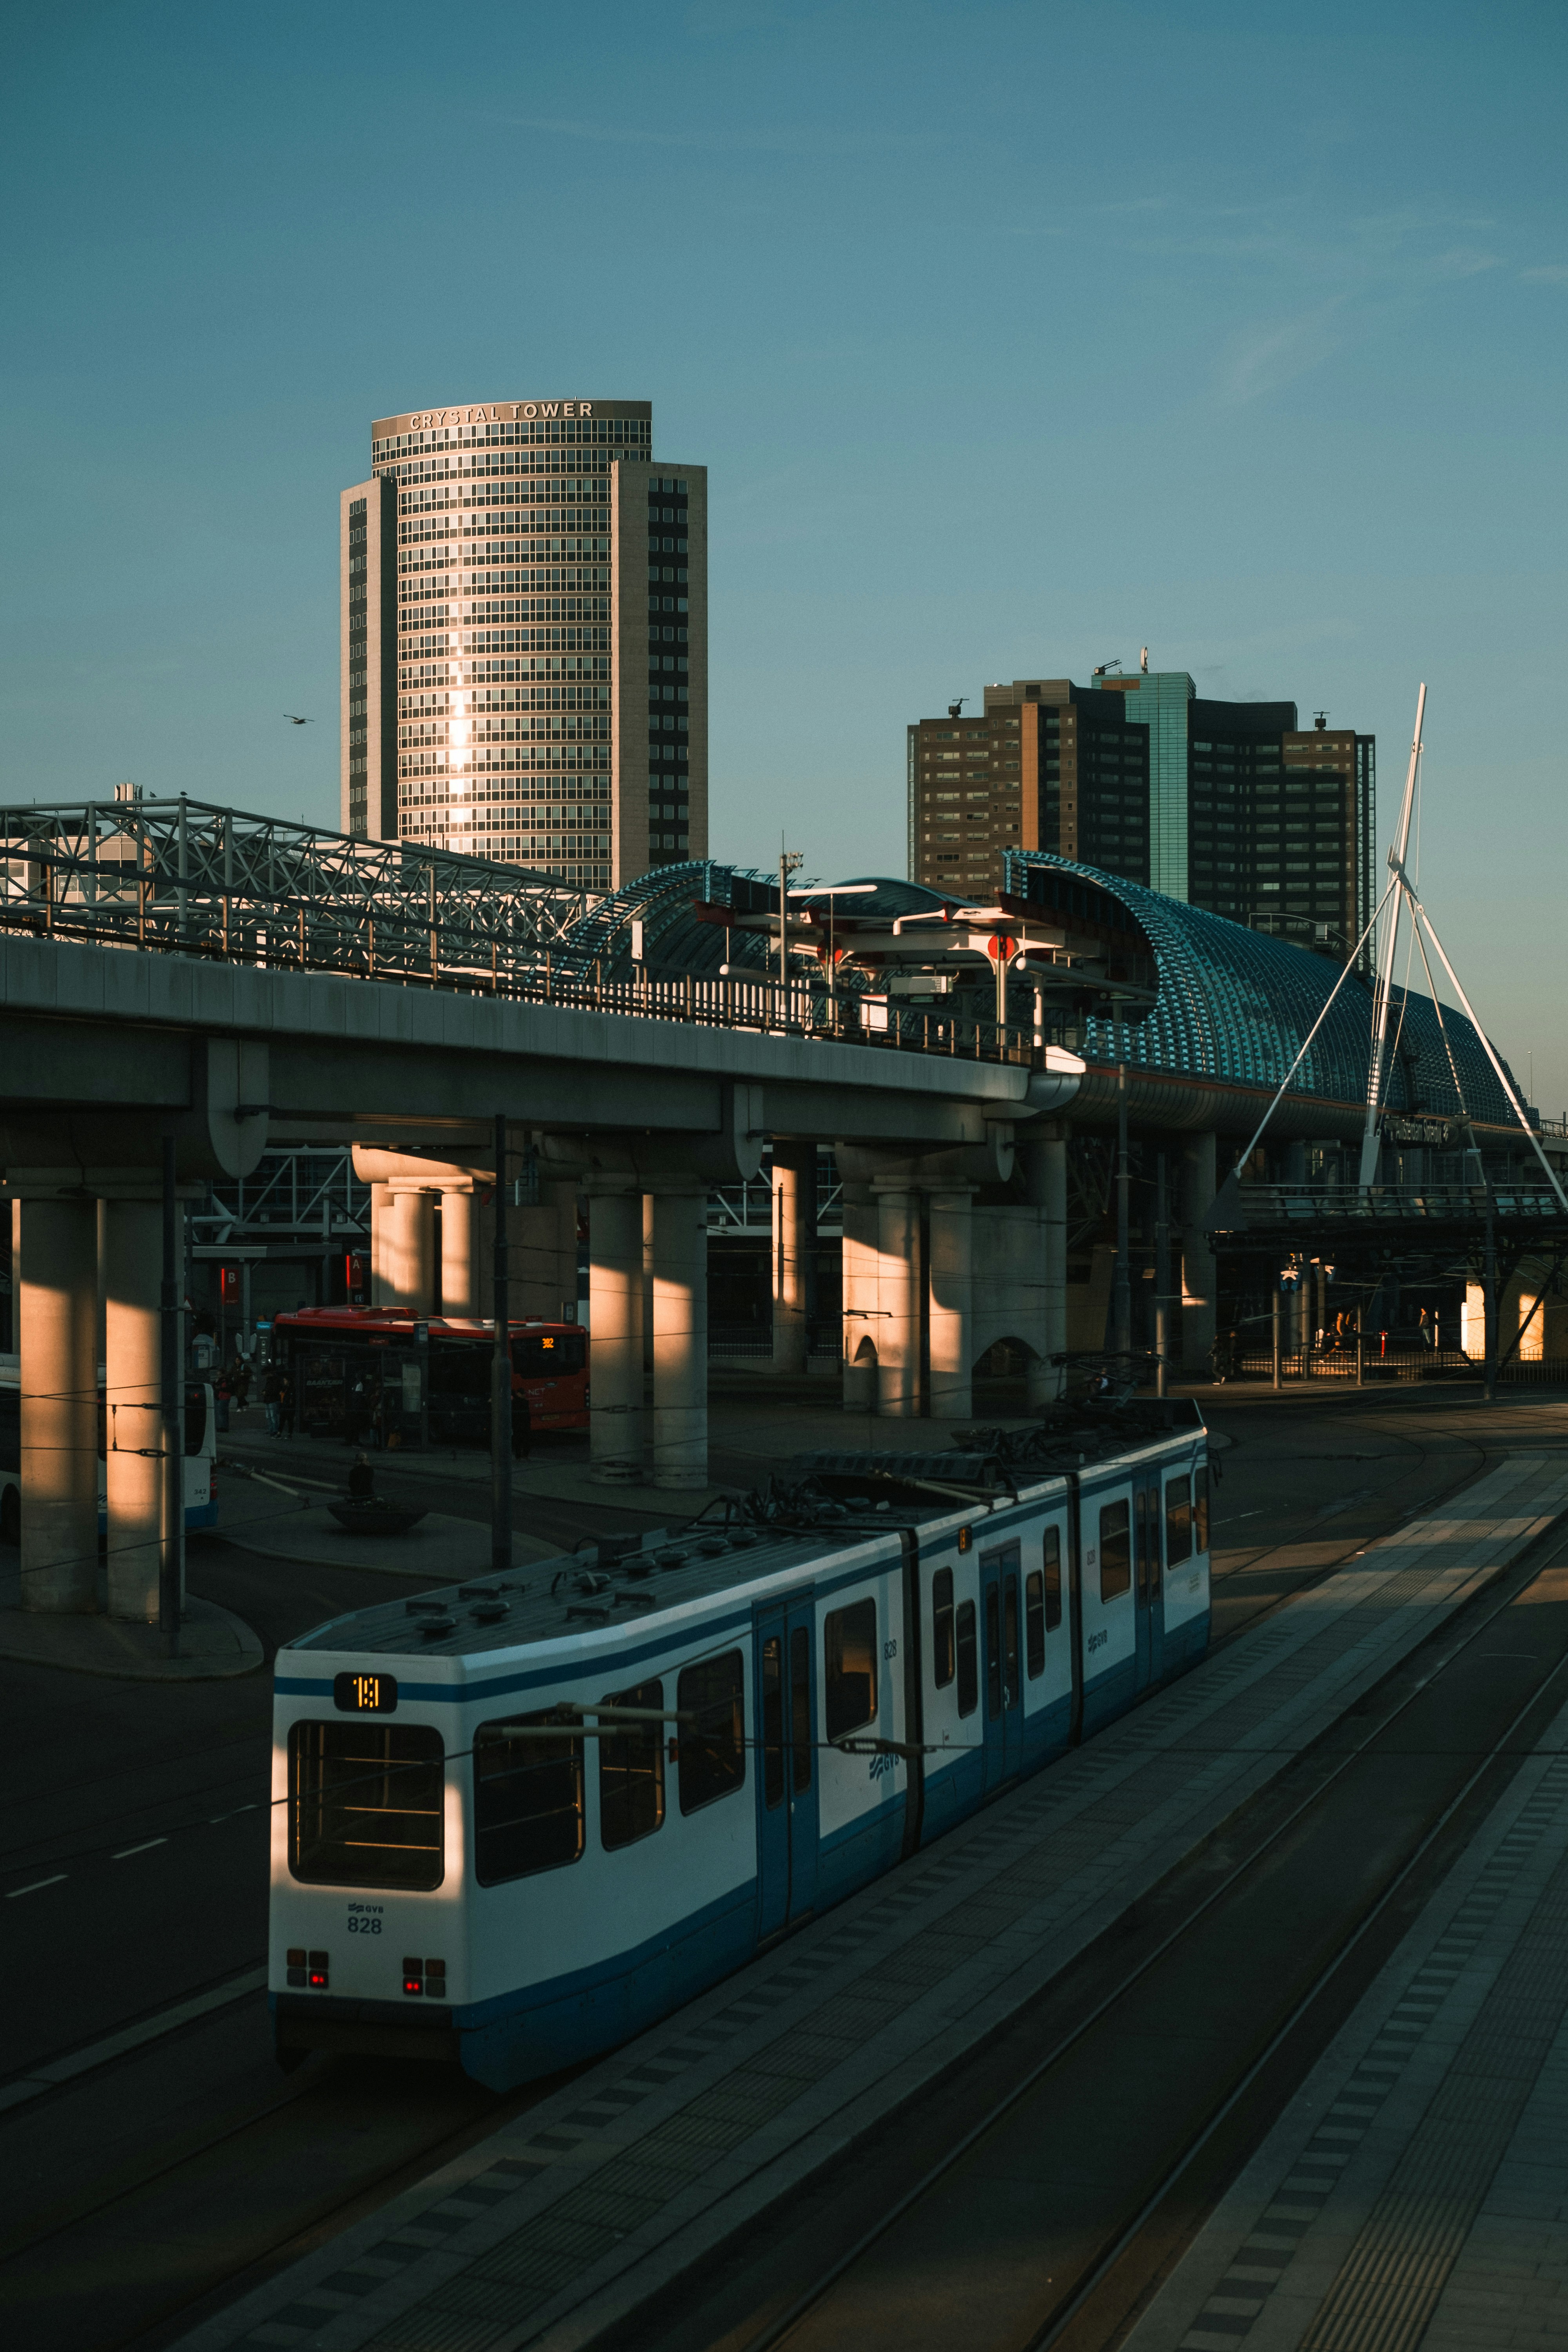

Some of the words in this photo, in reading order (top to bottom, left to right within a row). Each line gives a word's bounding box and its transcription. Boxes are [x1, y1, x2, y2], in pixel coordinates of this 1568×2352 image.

[410, 407, 500, 430] CRYSTAL
[510, 403, 593, 419] TOWER
[353, 1259, 360, 1269] A
[228, 1272, 236, 1283] B
[884, 1639, 897, 1661] 828
[365, 1905, 384, 1913] GVB
[348, 1916, 382, 1935] 828
